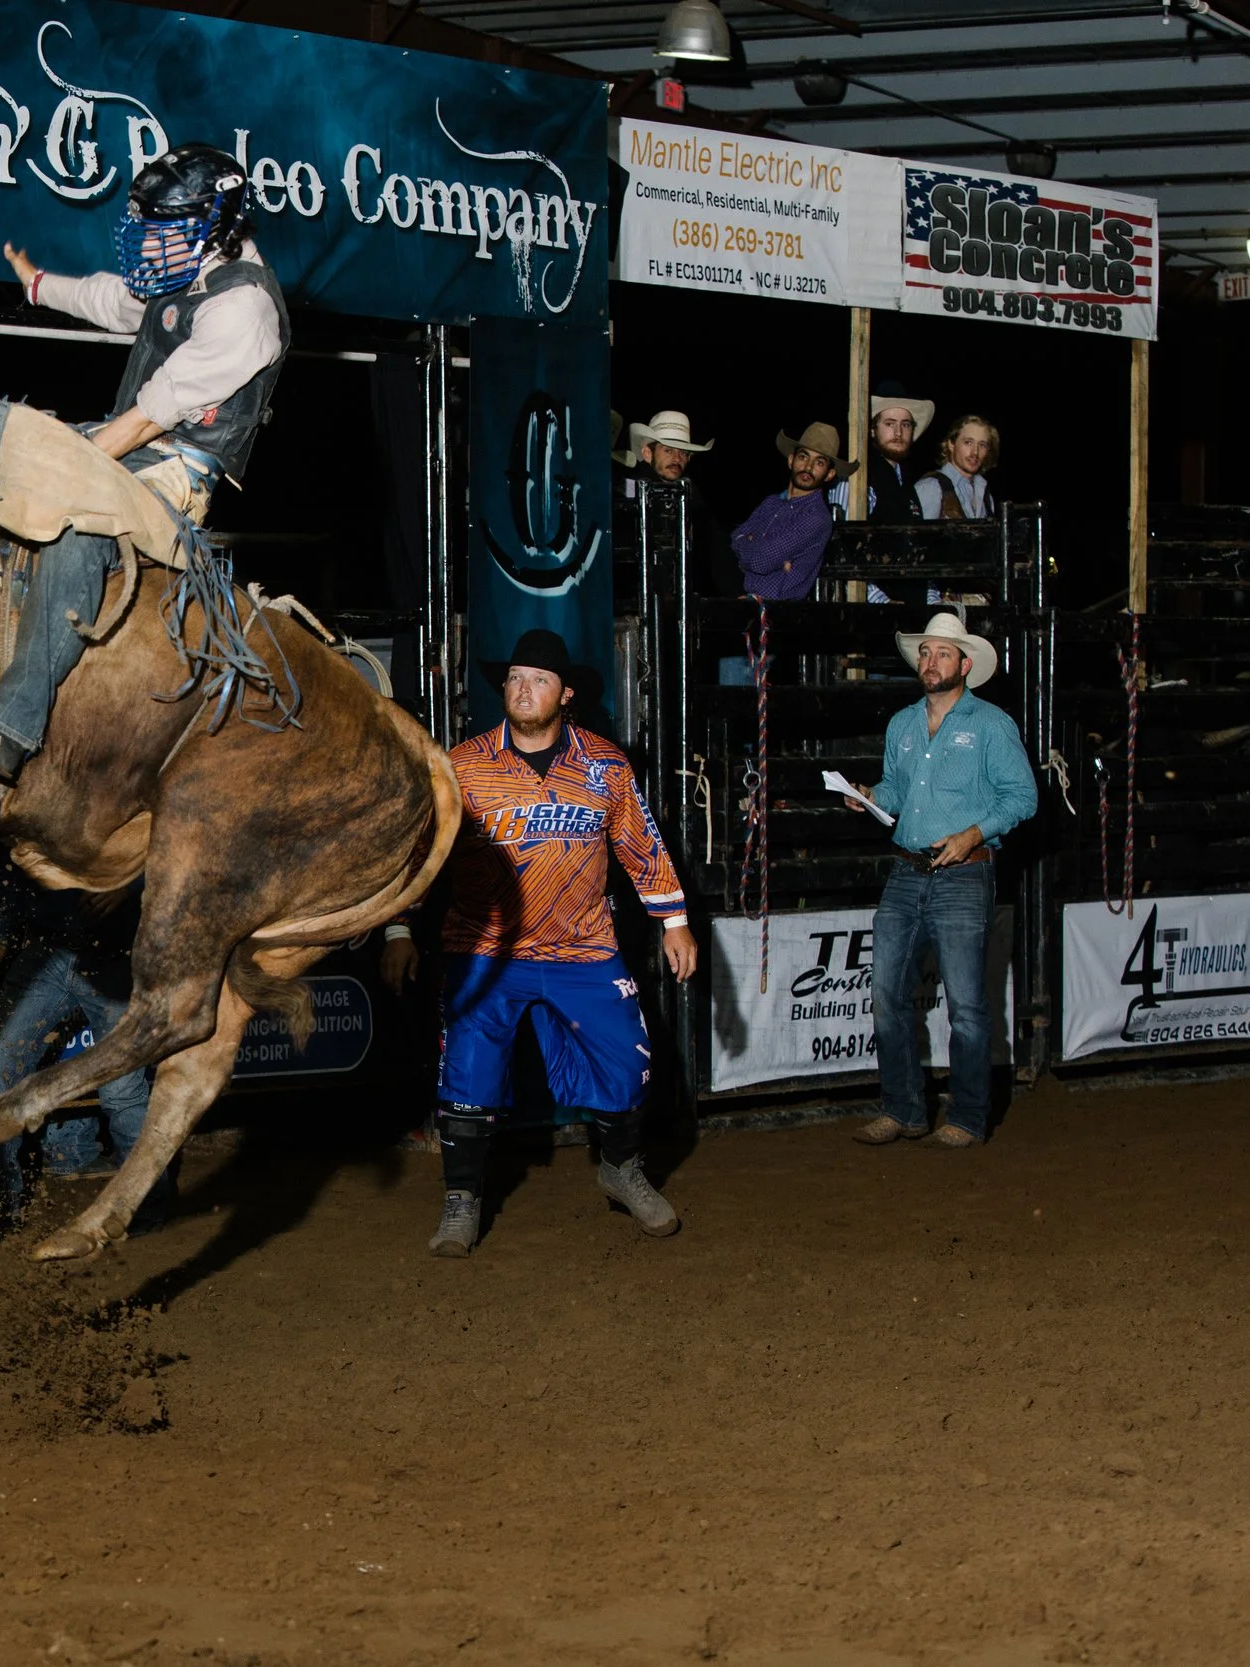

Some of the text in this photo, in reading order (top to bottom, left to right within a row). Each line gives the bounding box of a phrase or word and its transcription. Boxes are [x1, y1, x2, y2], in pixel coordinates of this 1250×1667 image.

[630, 130, 842, 192] Mantle Electric Inc
[126, 115, 326, 216] Reo
[341, 143, 597, 285] Company
[636, 182, 840, 227] Commerical, Residential, Multi-Family
[672, 218, 804, 259] (386) 269-3781
[930, 184, 1135, 262] Sloan's
[649, 260, 664, 277] FL
[676, 262, 742, 285] EC13011714
[784, 274, 827, 295] U.32176
[929, 228, 1135, 296] Concrete
[943, 286, 1123, 332] 904.803.7993
[482, 803, 607, 827] HUGHES
[1178, 943, 1247, 976] HYDRAULICS,
[791, 1001, 857, 1021] Building
[1150, 1021, 1250, 1042] 904 826 544
